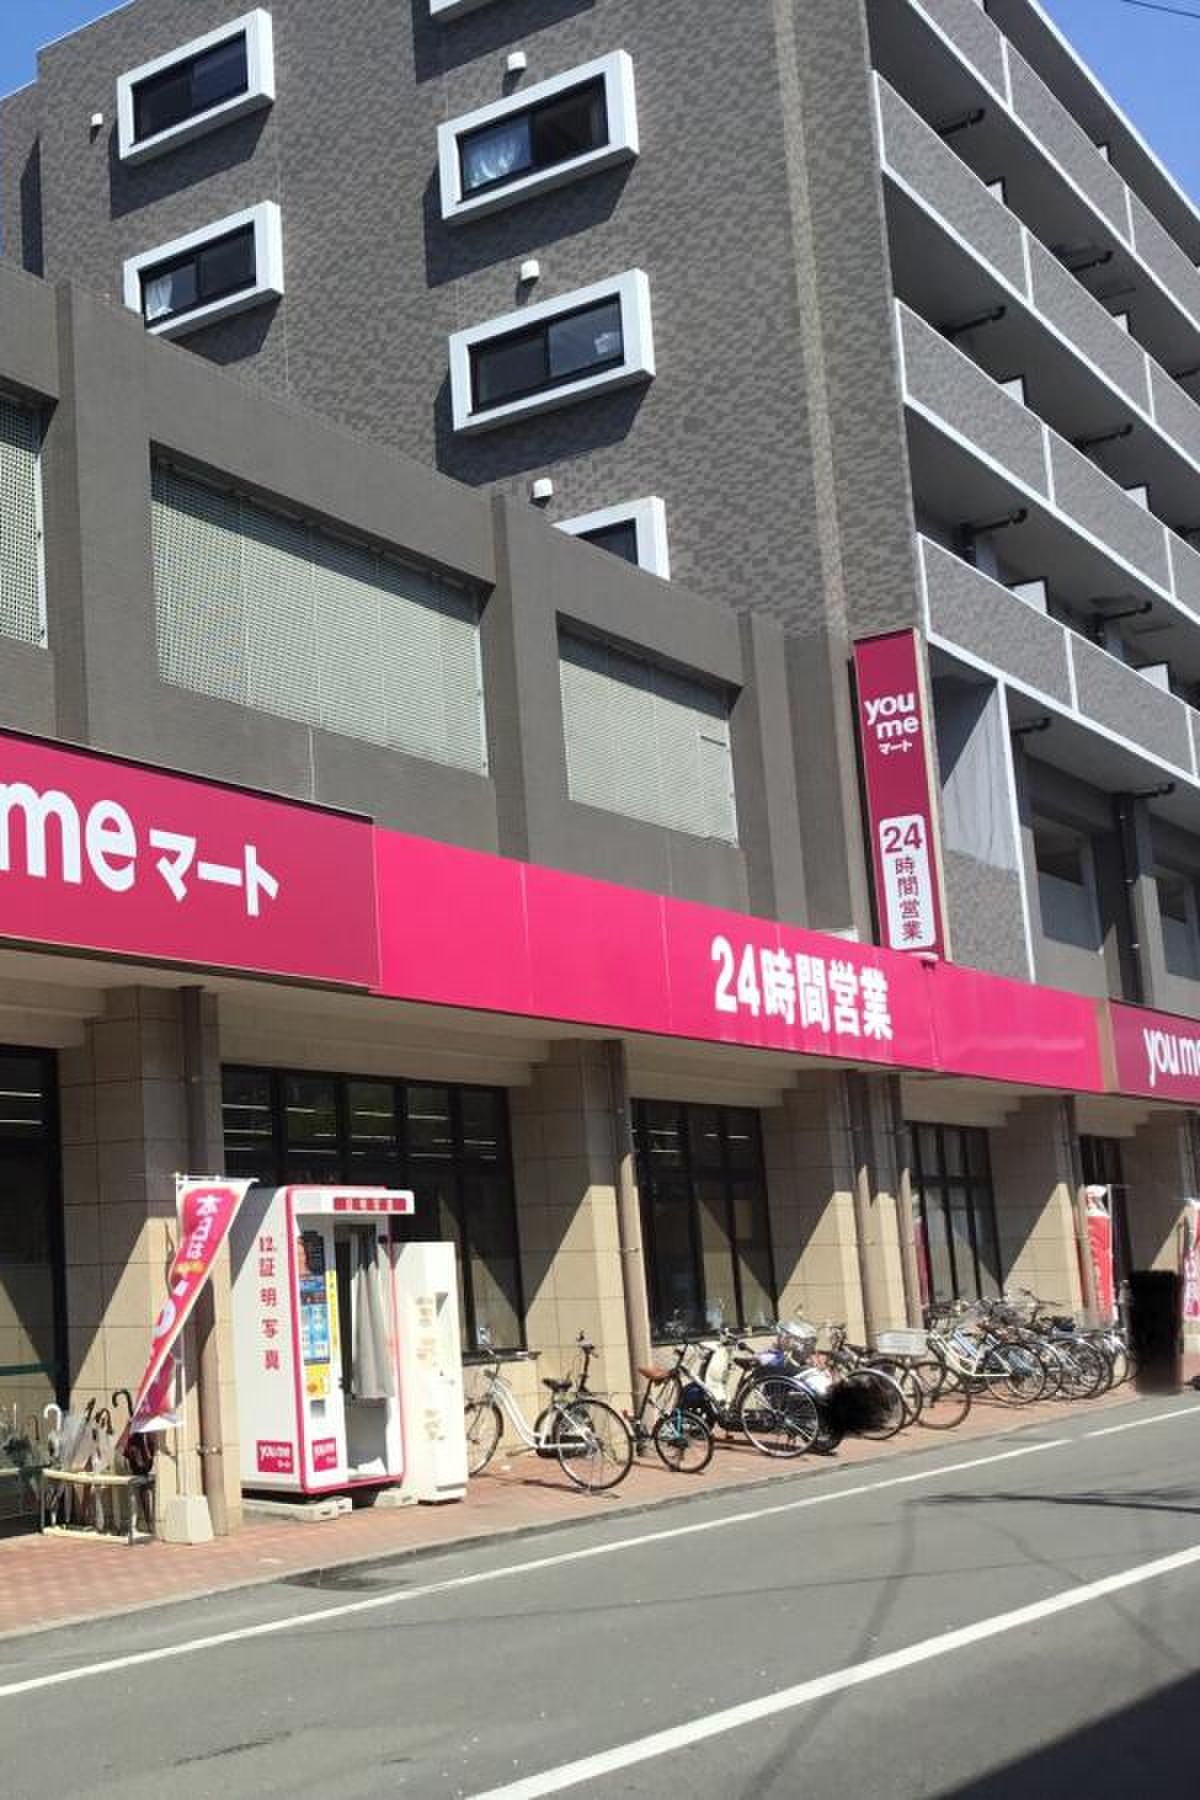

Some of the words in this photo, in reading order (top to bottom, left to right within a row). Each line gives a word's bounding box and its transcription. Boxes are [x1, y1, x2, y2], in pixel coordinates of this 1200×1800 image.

[864, 692, 916, 725] you
[876, 715, 919, 740] me
[878, 739, 913, 755] マート
[149, 828, 279, 917] マート
[711, 935, 893, 1041] 24時間営業
